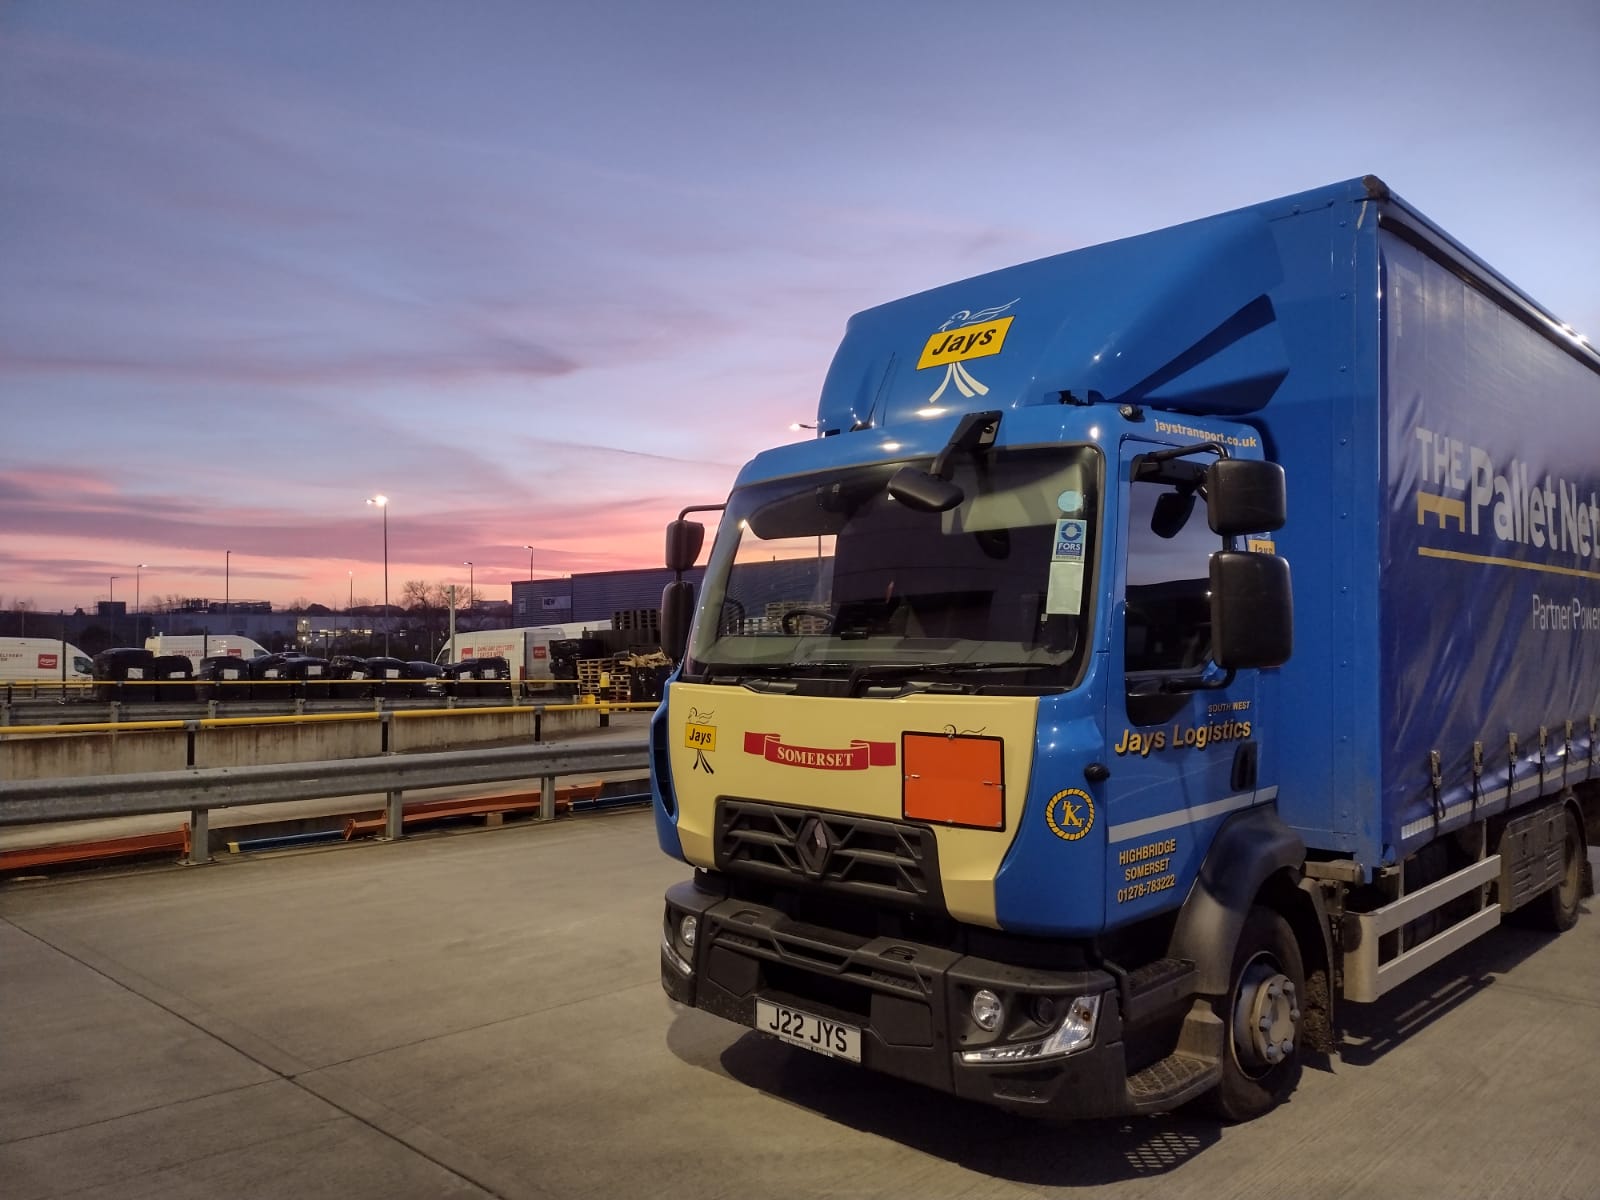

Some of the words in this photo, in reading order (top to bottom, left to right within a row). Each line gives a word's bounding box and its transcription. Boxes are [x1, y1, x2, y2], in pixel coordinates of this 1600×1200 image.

[932, 329, 997, 355] Jays
[1154, 419, 1257, 447] jaystransport.co.uk
[1416, 427, 1465, 491] THE
[1471, 446, 1557, 551] Pallet
[1058, 542, 1081, 551] FORS
[1533, 594, 1571, 630] Partner
[1208, 703, 1231, 712] SOUTH
[1232, 701, 1250, 711] WEST
[689, 728, 712, 744] Jays
[1114, 729, 1166, 756] Jays
[1172, 720, 1252, 749] Logistics
[777, 746, 854, 767] SOMERSET
[1119, 838, 1176, 866] HIGHBRIDGE
[1125, 858, 1170, 881] SOMERSET
[1117, 873, 1176, 904] 01278-783222
[769, 1007, 804, 1039] J22
[810, 1020, 847, 1052] JYS
